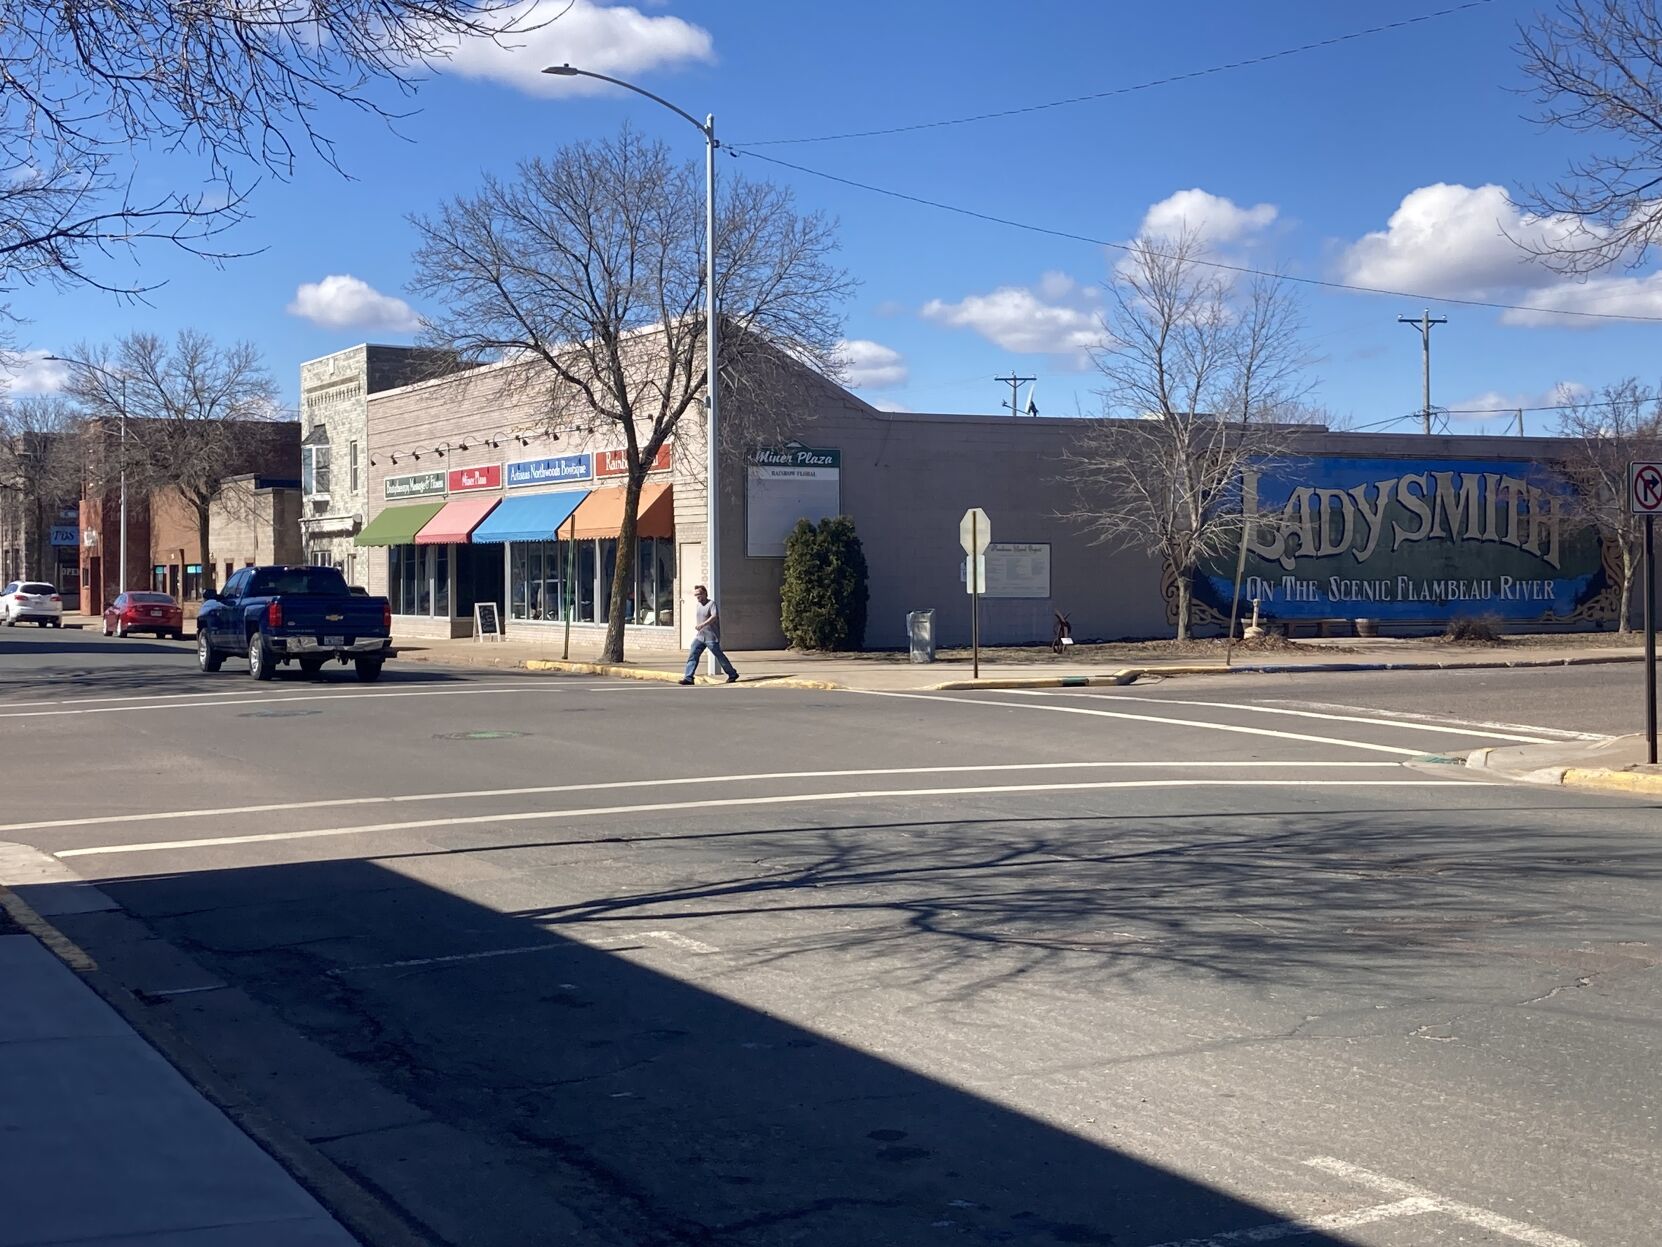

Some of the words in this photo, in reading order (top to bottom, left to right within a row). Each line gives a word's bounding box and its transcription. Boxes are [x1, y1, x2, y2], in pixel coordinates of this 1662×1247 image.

[605, 450, 630, 471] Rainb
[755, 450, 793, 464] Miner
[797, 451, 833, 464] Plaza
[530, 460, 561, 479] Northwoods
[1238, 468, 1561, 571] LADYSMITH
[1246, 576, 1274, 601] ON
[1282, 575, 1319, 601] THE
[1328, 576, 1391, 602] SCENIC
[1397, 576, 1492, 601] FLAMBEAU
[1500, 575, 1555, 600] RIVER
